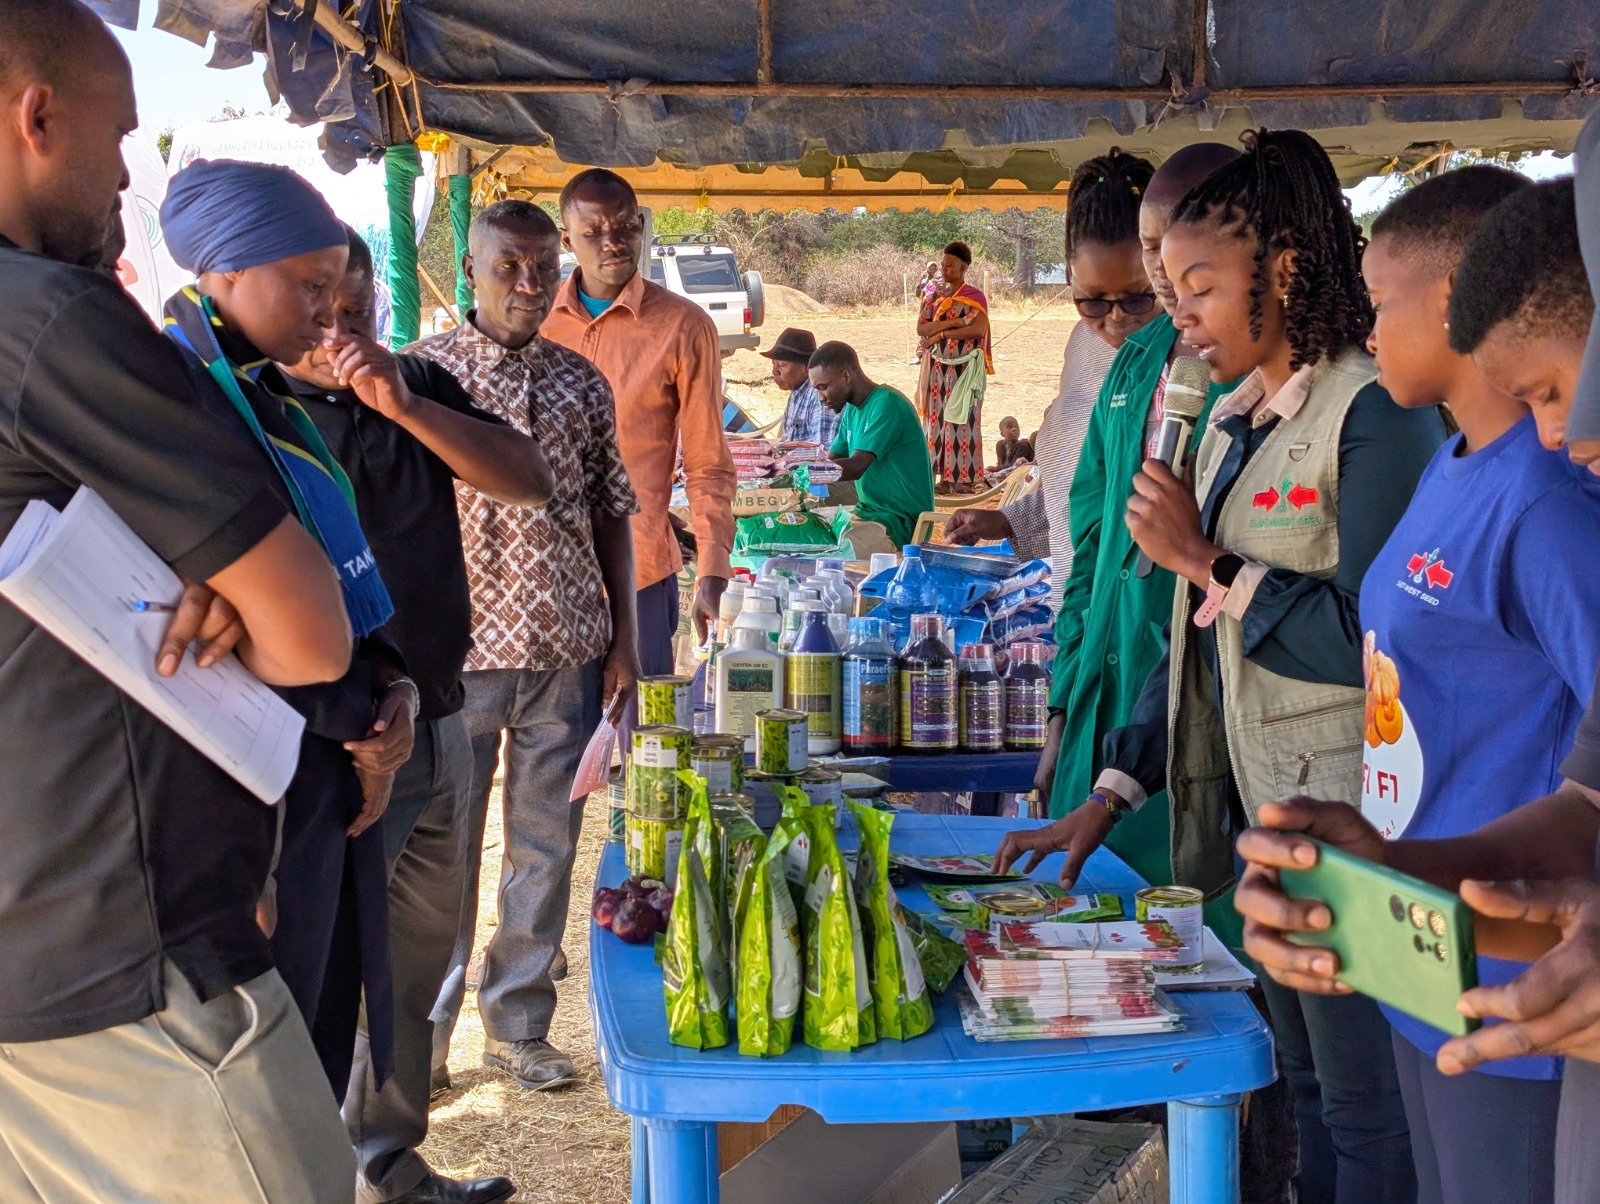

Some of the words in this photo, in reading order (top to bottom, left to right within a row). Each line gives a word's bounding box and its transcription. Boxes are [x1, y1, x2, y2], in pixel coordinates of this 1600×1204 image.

[733, 496, 789, 507] MBEGU
[1420, 592, 1440, 606] SEED
[1377, 770, 1398, 804] F1
[987, 1141, 1006, 1151] 20L
